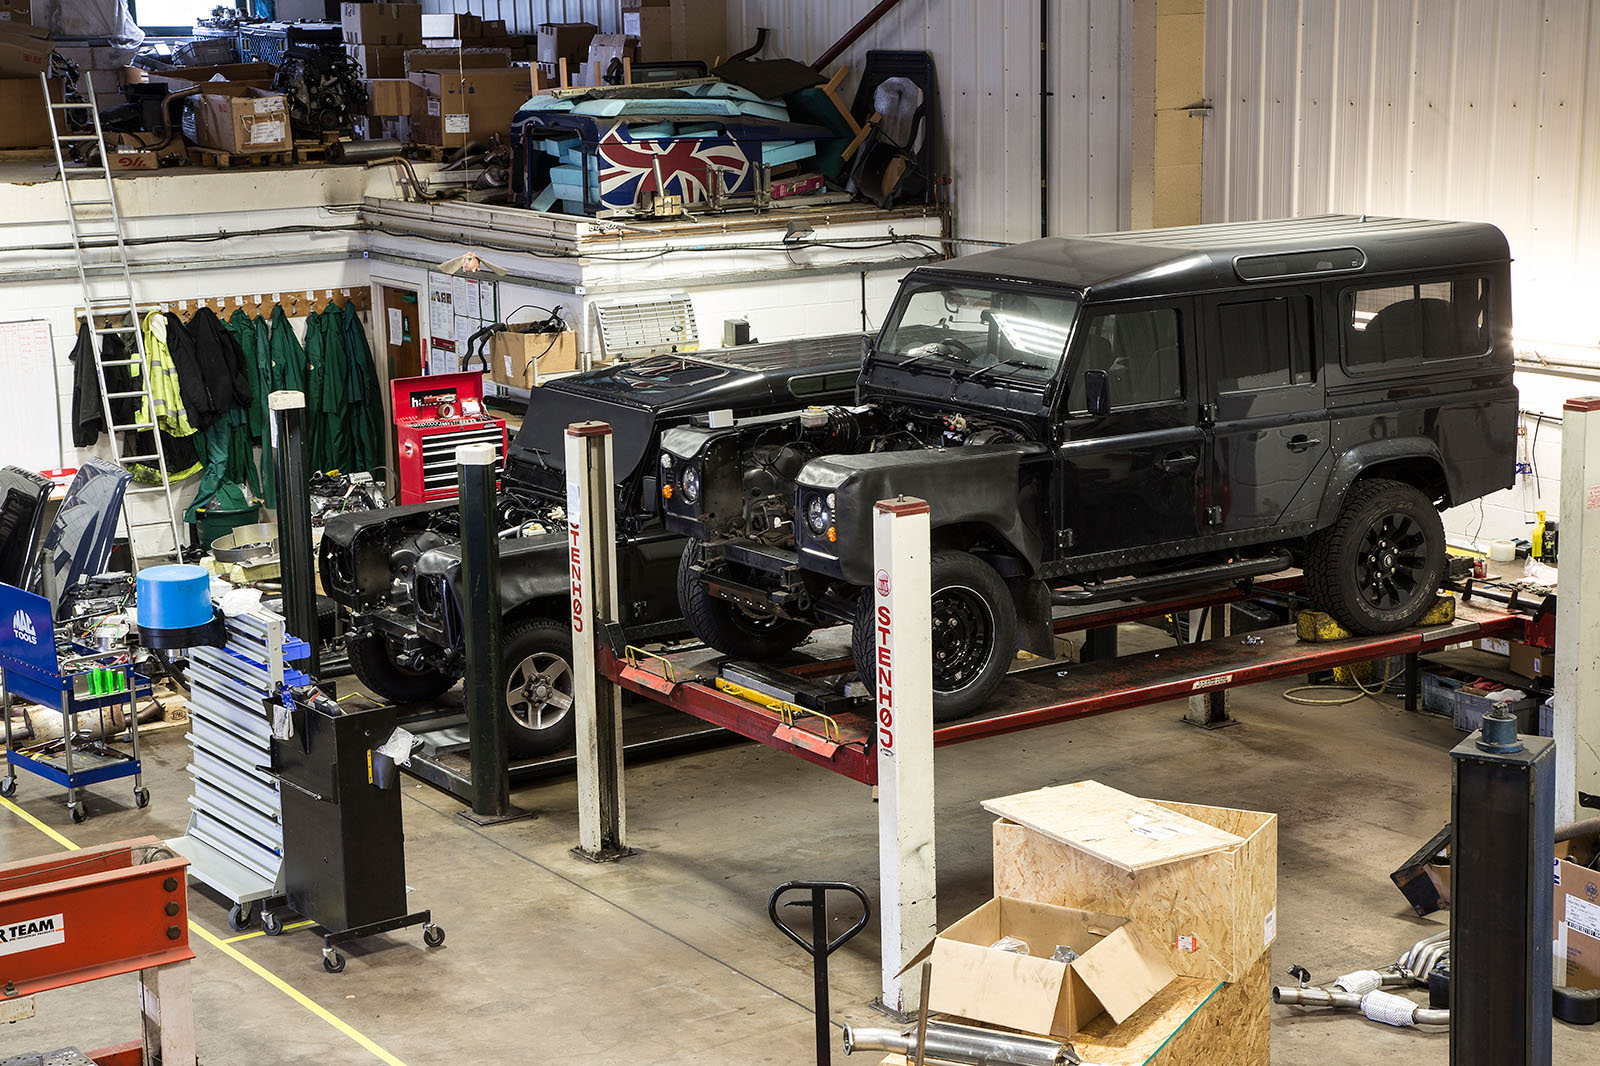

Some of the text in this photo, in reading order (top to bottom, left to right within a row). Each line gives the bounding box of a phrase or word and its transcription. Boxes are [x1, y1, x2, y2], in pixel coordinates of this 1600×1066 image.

[13, 609, 37, 636] MAC
[13, 629, 38, 645] TOOLS
[877, 605, 894, 749] STENHØJ
[9, 918, 54, 938] TEAM
